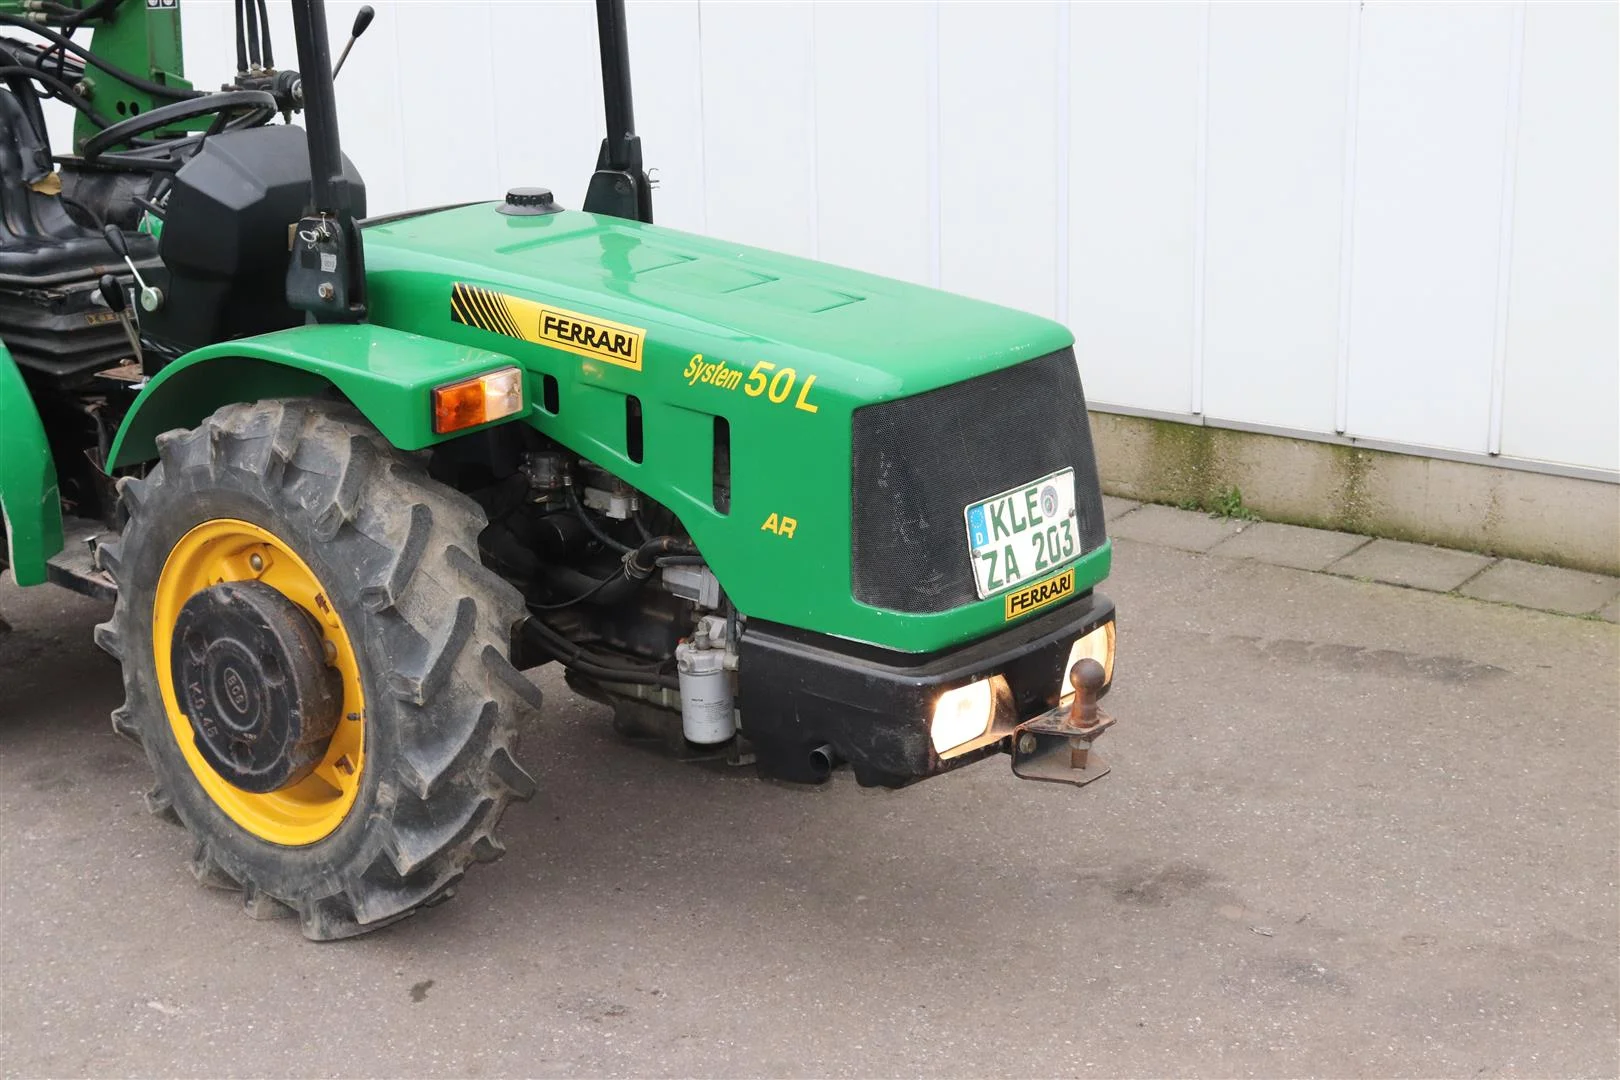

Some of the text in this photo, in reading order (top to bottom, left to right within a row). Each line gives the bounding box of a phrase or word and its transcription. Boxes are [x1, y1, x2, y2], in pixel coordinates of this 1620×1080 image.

[544, 316, 633, 357] FERRARI
[683, 354, 819, 414] System 50 L
[760, 512, 797, 539] AR
[989, 487, 1043, 542] KLE
[976, 532, 984, 545] D
[981, 518, 1074, 591] ZA 203
[1010, 574, 1071, 613] FERRARI
